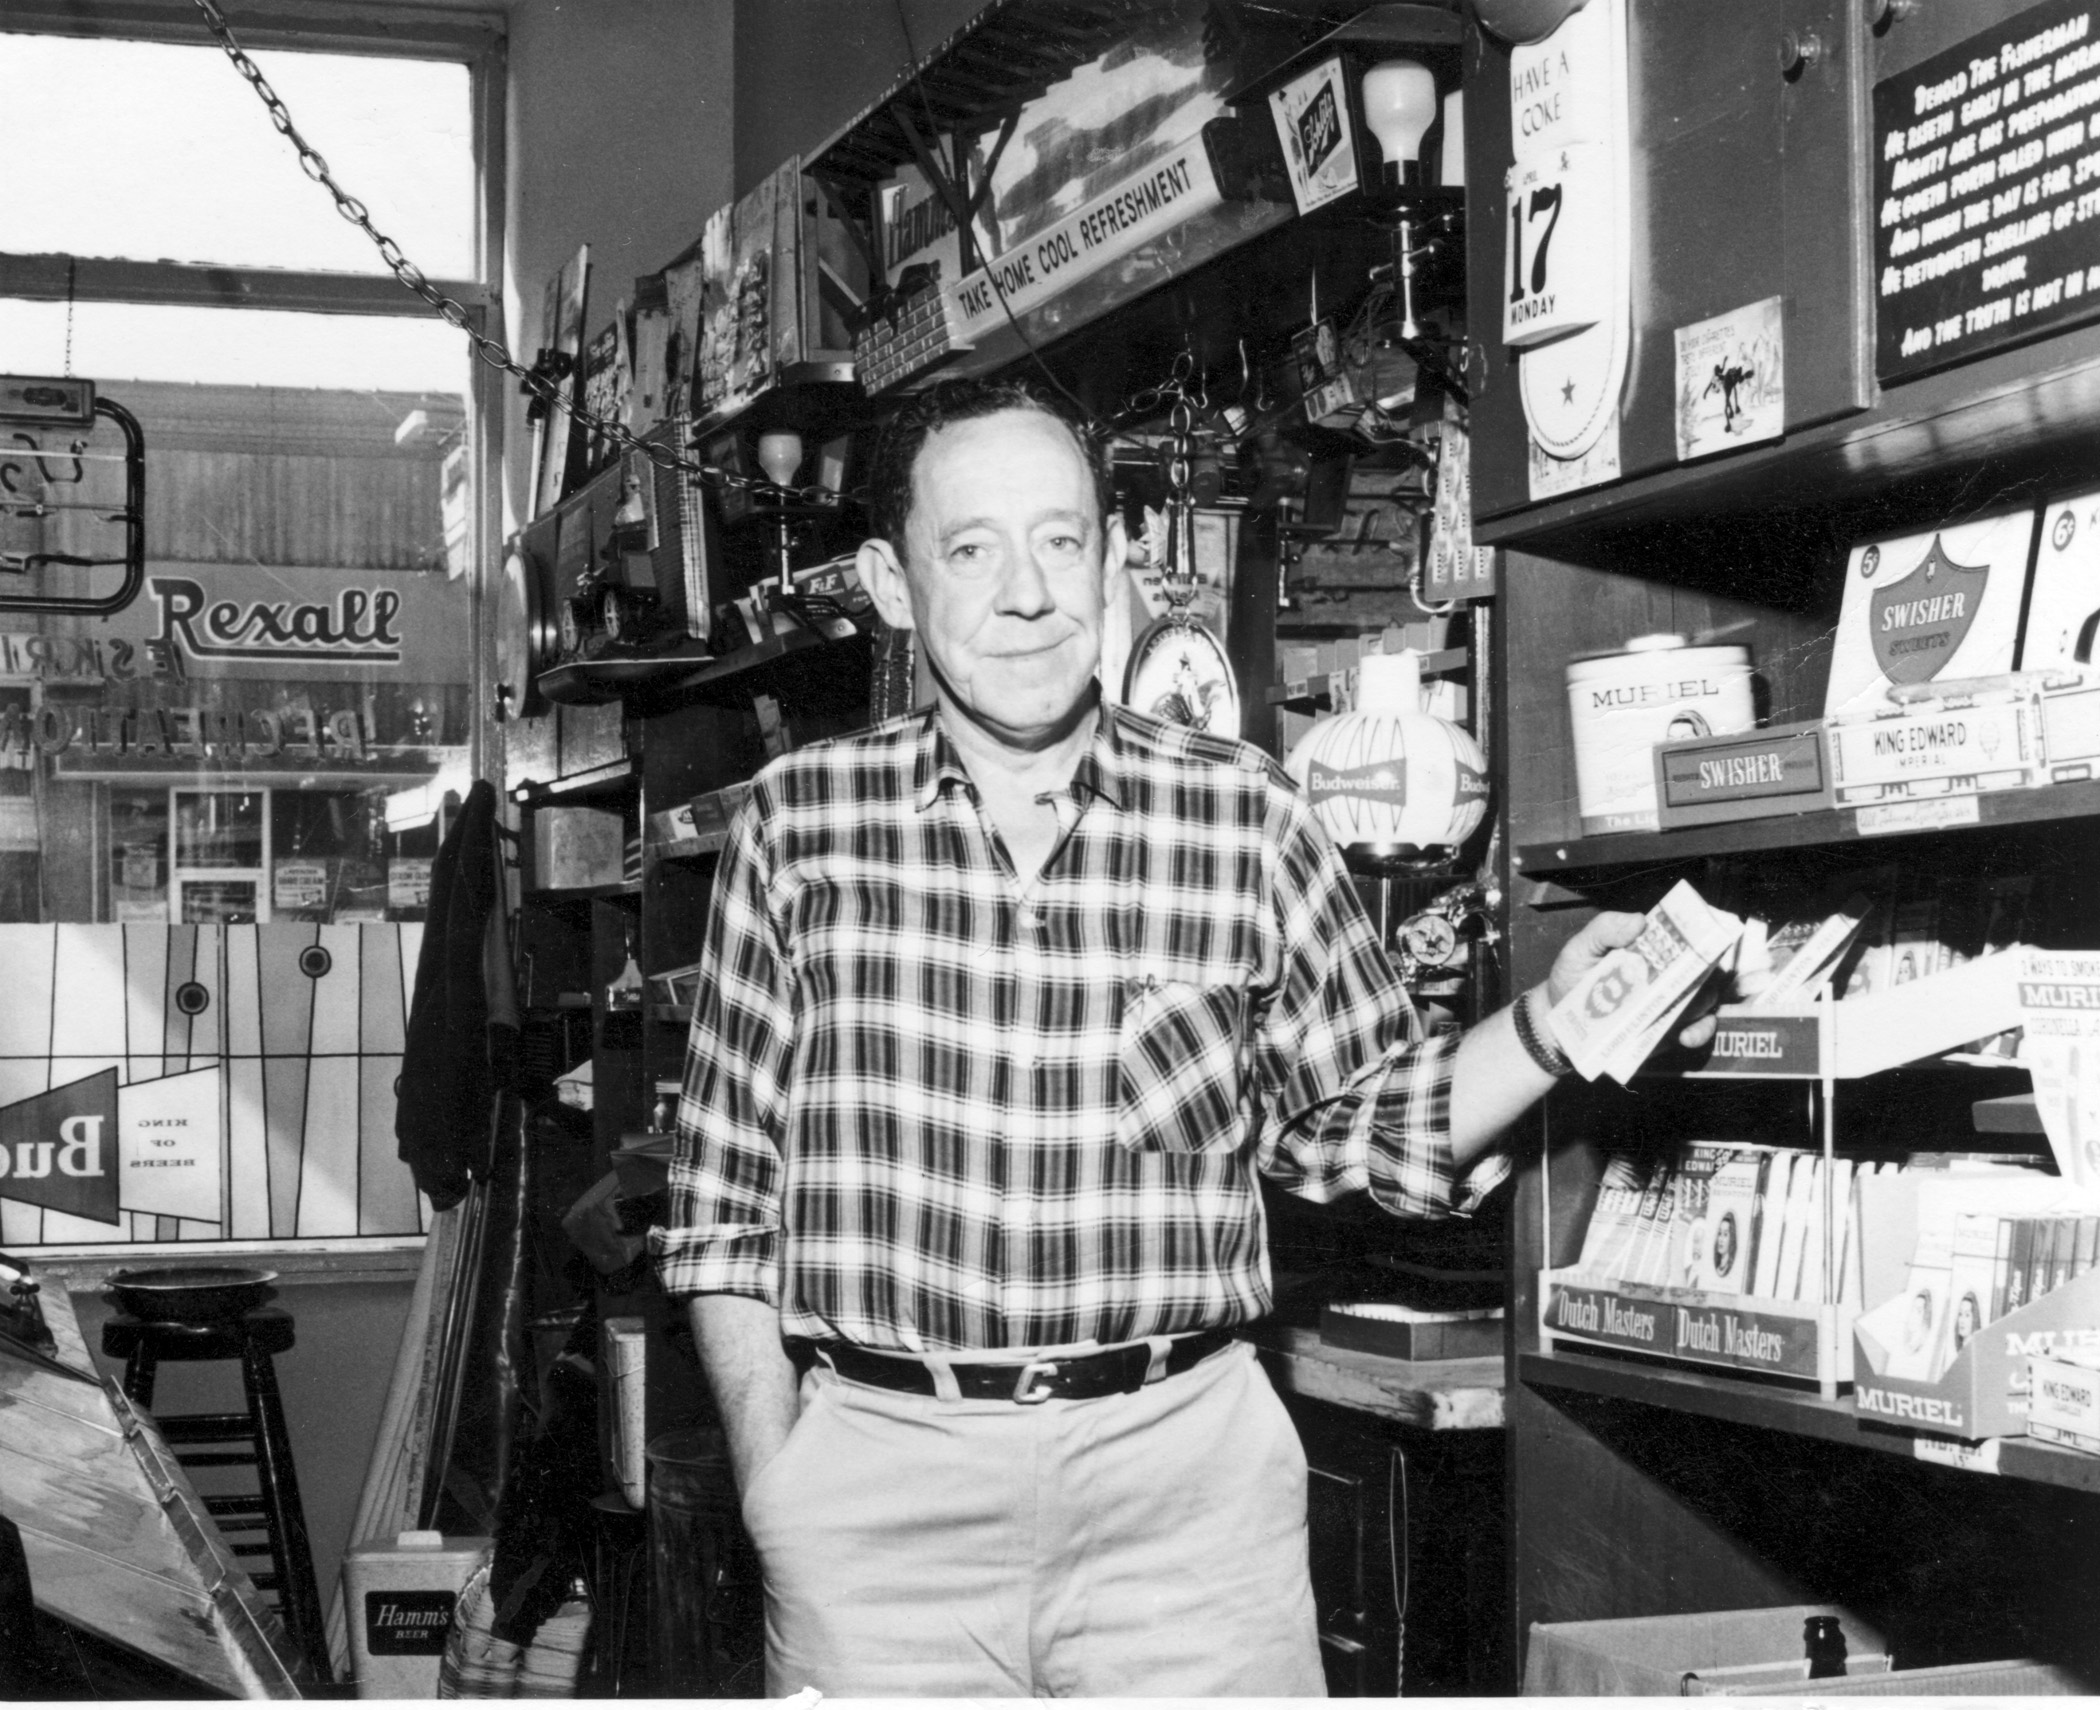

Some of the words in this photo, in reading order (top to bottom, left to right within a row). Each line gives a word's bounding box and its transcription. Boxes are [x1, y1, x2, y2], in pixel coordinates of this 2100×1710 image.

[1513, 57, 1550, 102] HAVE
[1558, 49, 1570, 75] A
[1521, 92, 1561, 137] COKE
[958, 281, 991, 321] TAKE
[993, 253, 1035, 308] HOME
[1038, 235, 1078, 275] COOL
[1082, 158, 1193, 251] REFRESHMENT
[1510, 182, 1563, 304] 17
[1510, 294, 1556, 326] MONDAY
[146, 576, 401, 655] Rexall
[1881, 592, 1965, 632] SWISHER
[1592, 679, 1719, 708] MURIEL
[1874, 729, 1904, 756] KING
[1910, 722, 1966, 751] EDWARD
[1700, 752, 1784, 789] SWISHER
[1685, 1161, 1715, 1173] EDWA
[1558, 1285, 1599, 1333] Dutch
[1603, 1294, 1655, 1342] Masters
[1677, 1308, 1720, 1353] Dutch
[1724, 1316, 1782, 1363] Masters
[1856, 1386, 1963, 1427] MURIEL
[375, 1604, 448, 1627] Hamm's
[395, 1630, 428, 1639] BEER
